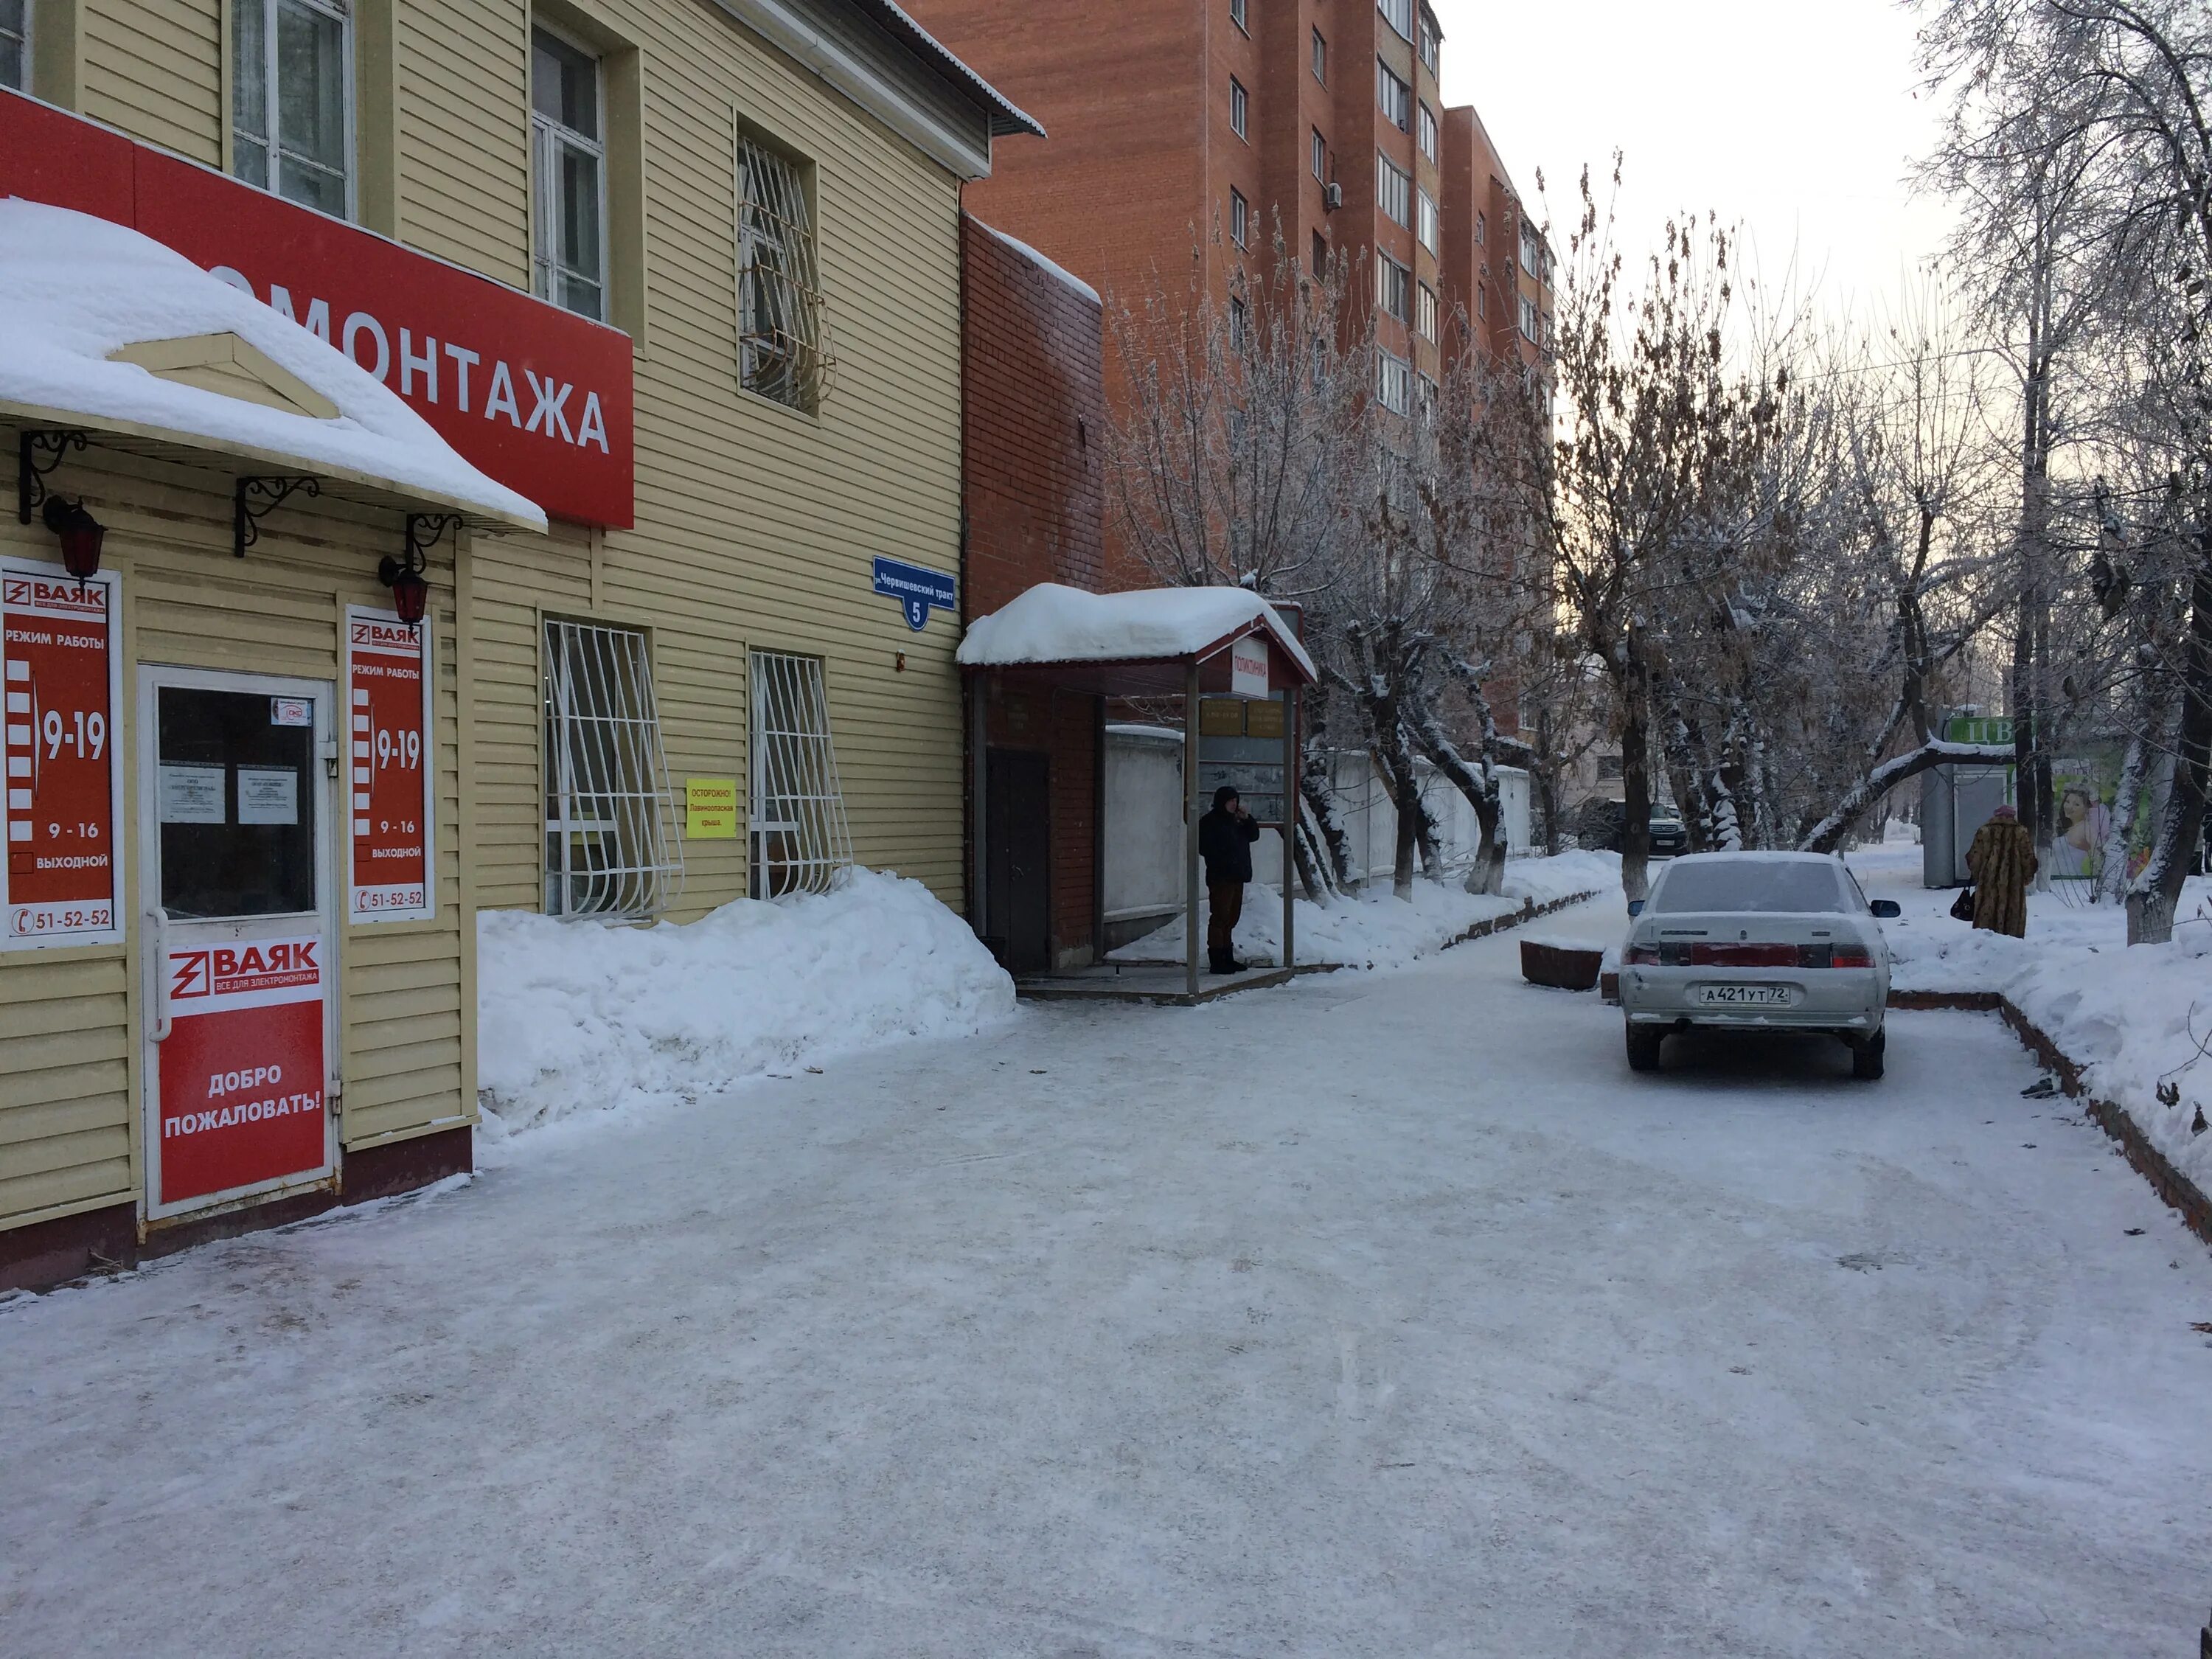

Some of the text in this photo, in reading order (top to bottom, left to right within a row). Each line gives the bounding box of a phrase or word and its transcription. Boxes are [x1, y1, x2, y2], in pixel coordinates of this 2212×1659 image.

[209, 265, 609, 454] МОНТАЖА
[34, 582, 104, 606] ВАЯК
[880, 572, 934, 596] Червишевский
[935, 589, 953, 600] тракт
[912, 602, 921, 622] 5
[6, 629, 104, 650] РЕЖИМ РАБОТЫ
[372, 625, 420, 644] ВАЯК
[352, 664, 420, 679] РЕЖИМ РАБОТЫ
[44, 709, 105, 760] 9-19
[378, 729, 420, 770] 9-19
[692, 789, 731, 797] ОСТОРОЖНО!
[689, 803, 734, 812] Лавиноопасная
[701, 819, 722, 827] крыша.
[37, 853, 108, 869] ВЫХОДНОЙ
[372, 846, 421, 858] ВЫХОДНОЙ
[372, 891, 422, 907] 51-52-52
[36, 909, 109, 929] 51-52-52
[213, 942, 319, 977] ВАЯК
[216, 972, 318, 991] ВСЕ ДЛЯ ЭЛЕКТРОМОНТАЖА
[208, 1065, 282, 1098] ДОБРО
[164, 1091, 321, 1138] ПОЖАЛОВАТЬ!
